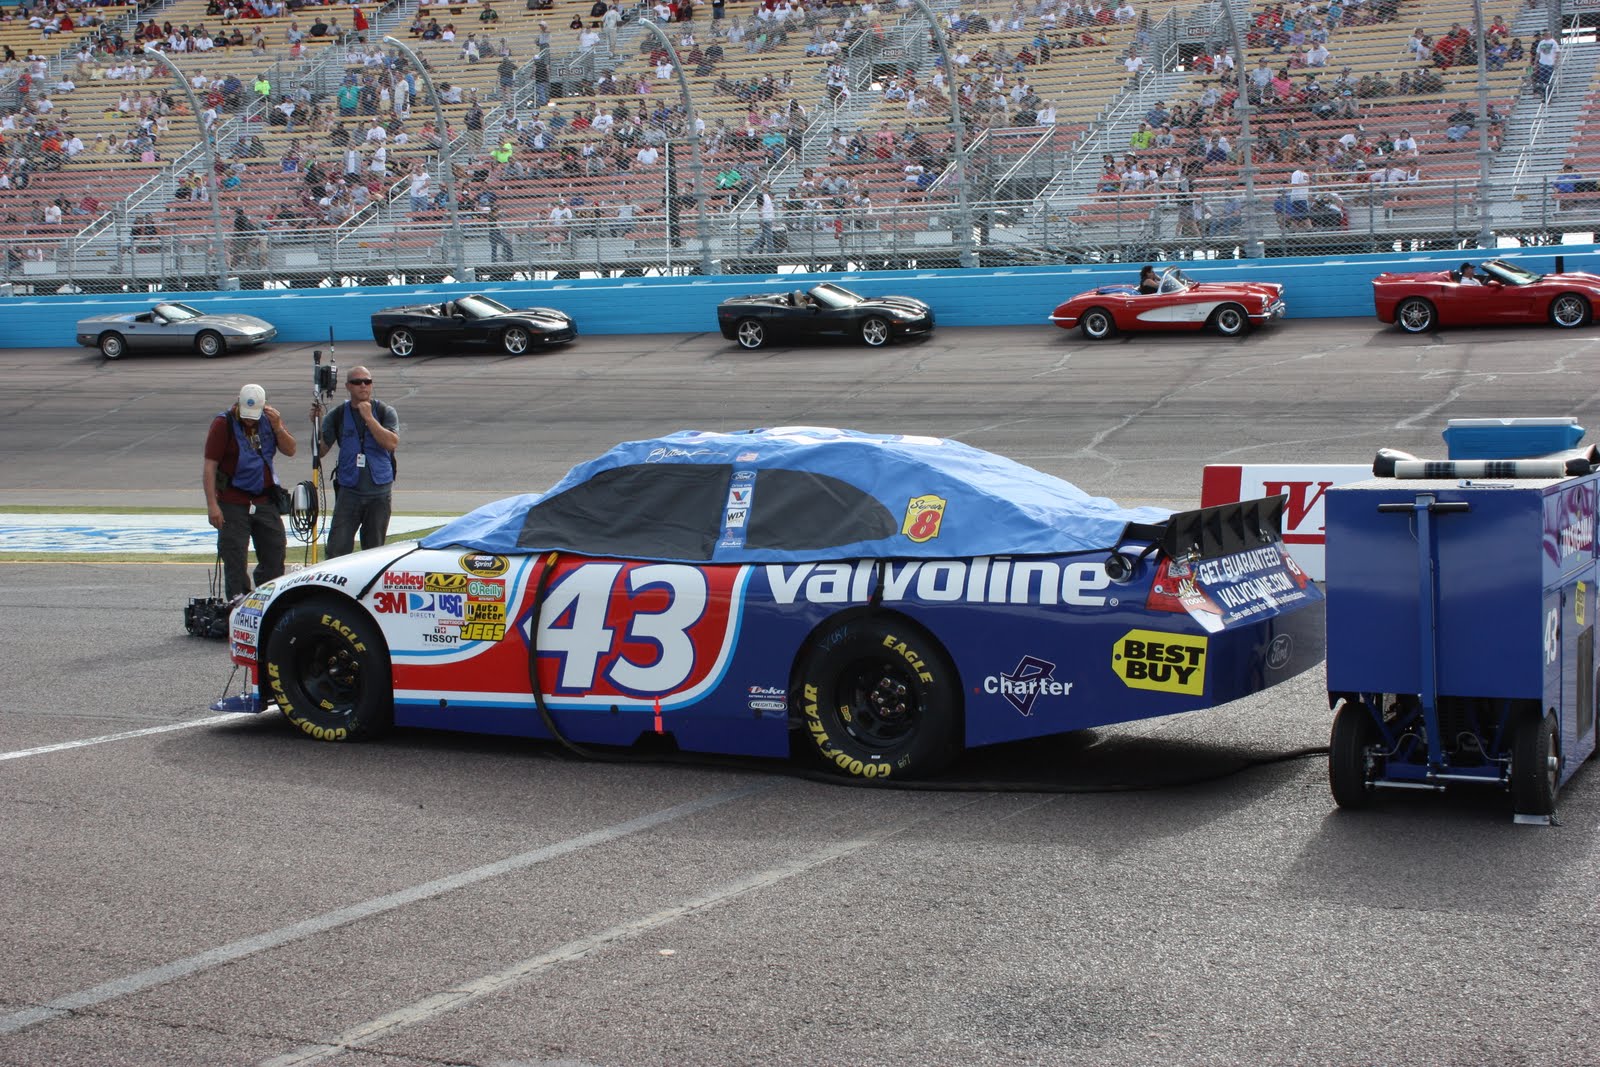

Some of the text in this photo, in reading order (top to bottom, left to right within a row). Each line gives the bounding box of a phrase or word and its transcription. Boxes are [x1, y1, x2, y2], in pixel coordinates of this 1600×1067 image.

[727, 510, 745, 521] WIX
[908, 509, 941, 539] 8
[474, 560, 493, 568] Sprint
[1200, 546, 1281, 586] GET GUARANTEED
[280, 573, 348, 592] GOODYEAR
[384, 572, 424, 590] Holley
[469, 581, 502, 598] O'Reilly
[1217, 571, 1294, 609] VALVOLINE.COM
[373, 592, 407, 614] 3M
[438, 594, 463, 617] USG
[476, 604, 498, 612] Auto
[233, 612, 257, 629] MAHLE
[474, 612, 503, 620] Meter
[321, 614, 366, 653] EAGLE
[422, 634, 459, 643] TISSOT
[461, 624, 506, 641] JEGS
[522, 562, 708, 694] 43
[1544, 607, 1558, 665] 43
[882, 634, 934, 684] EAGLE
[1124, 639, 1205, 666] BEST
[1125, 660, 1198, 685] BUY
[983, 675, 1073, 696] Charter
[267, 662, 347, 741] GOODYEAR
[804, 683, 892, 779] GOODYEAR
